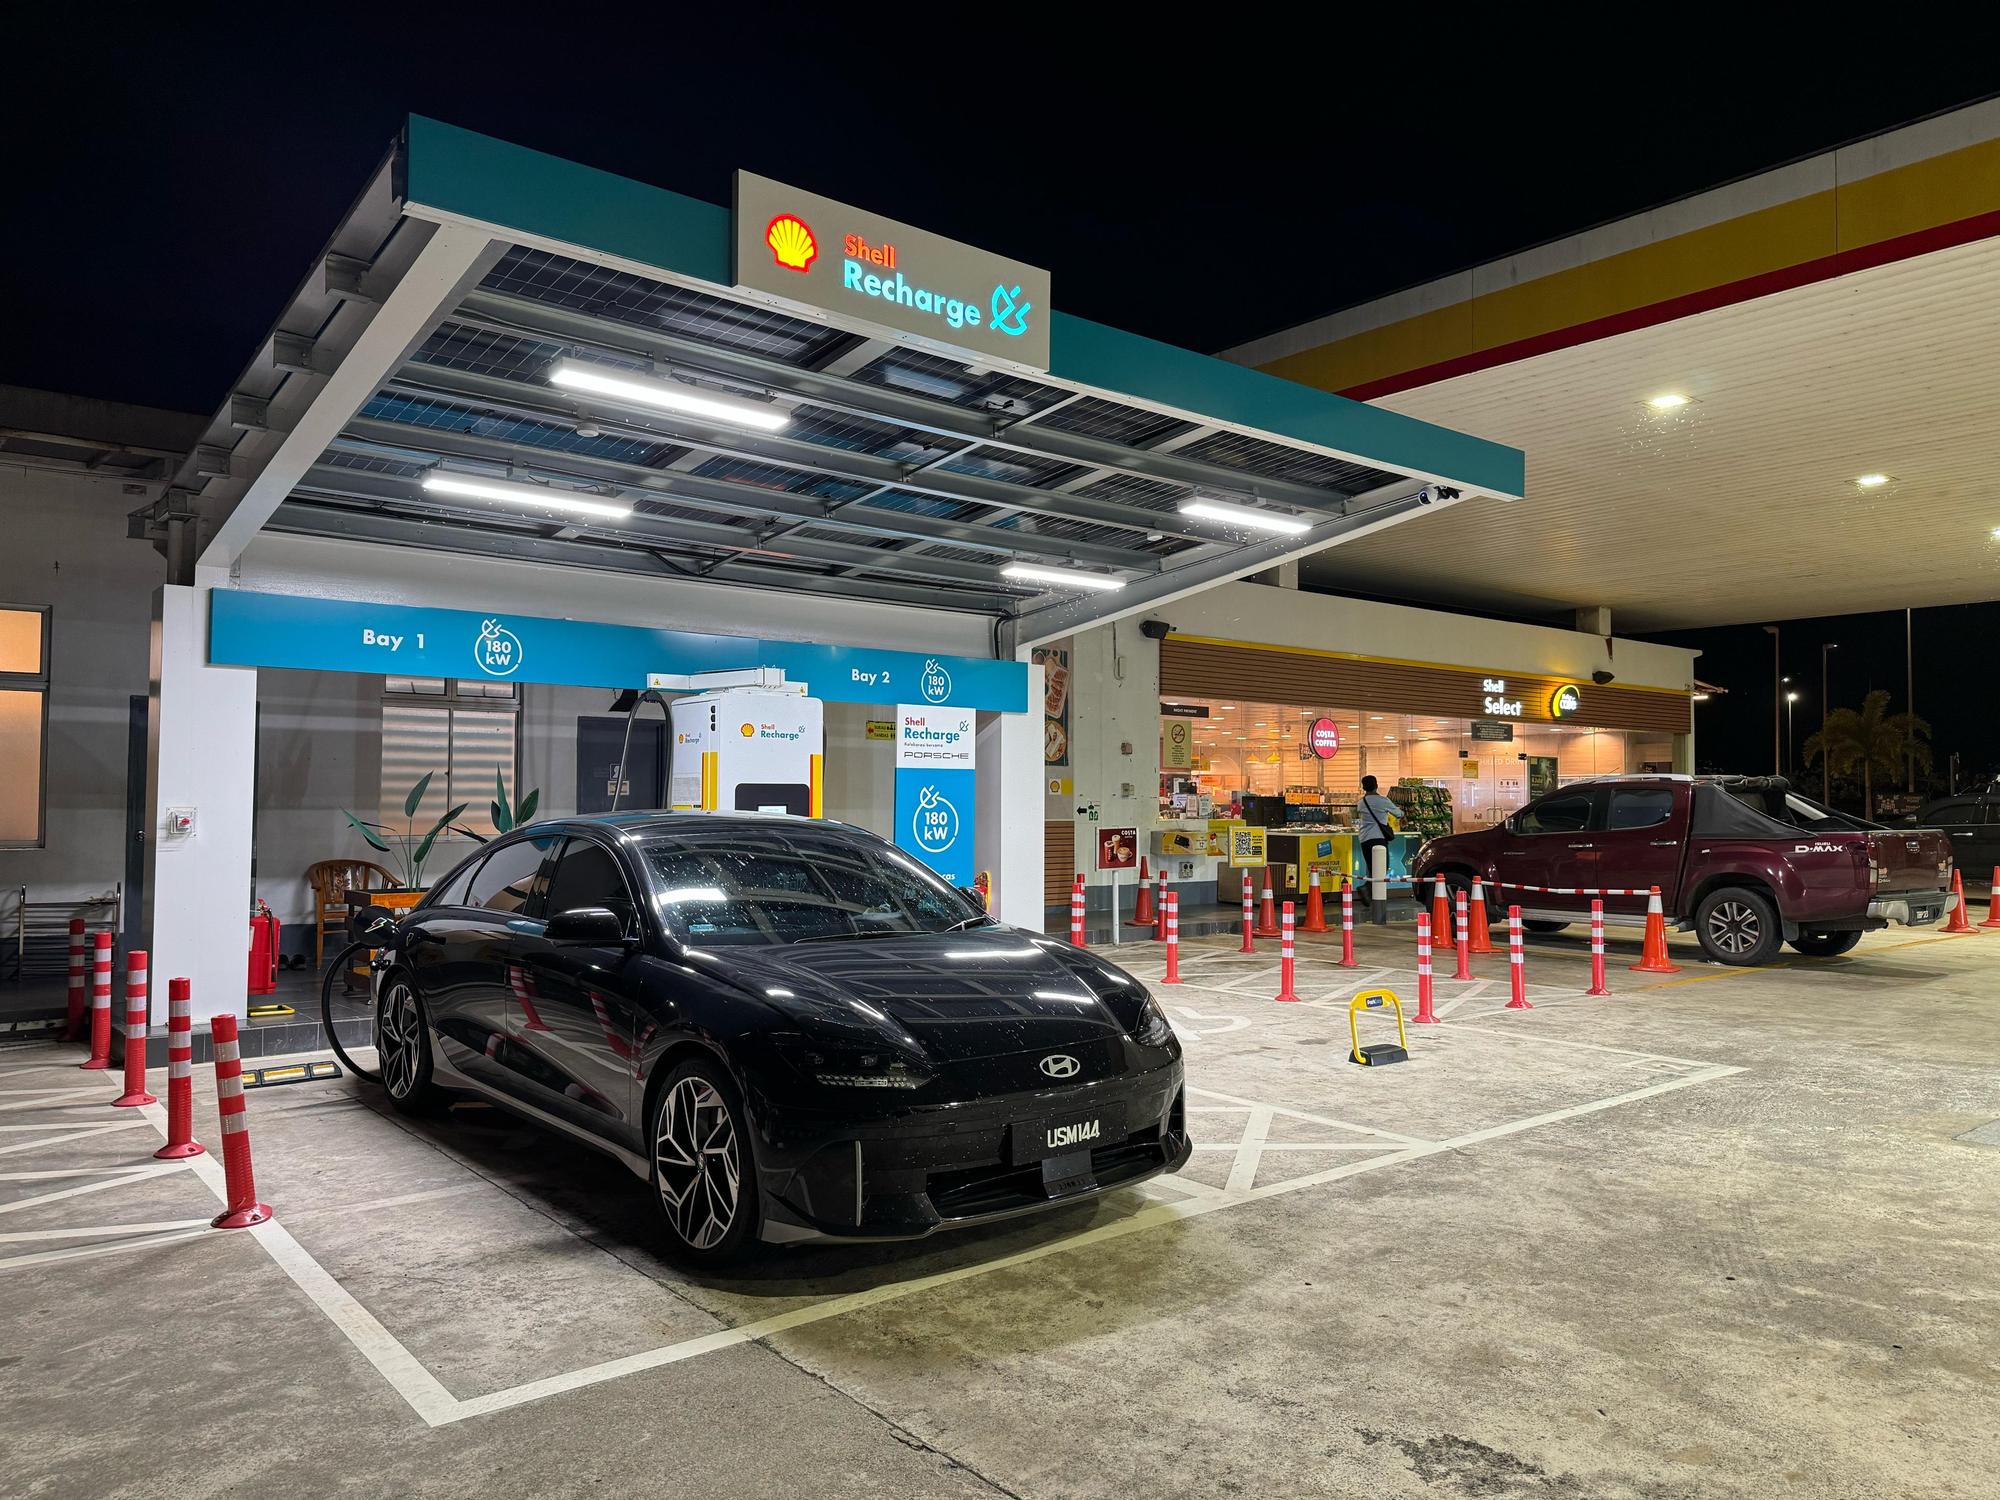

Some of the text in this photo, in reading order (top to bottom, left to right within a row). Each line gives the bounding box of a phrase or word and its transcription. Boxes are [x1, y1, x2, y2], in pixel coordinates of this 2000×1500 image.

[844, 233, 896, 269] Shell
[844, 259, 981, 329] Recharge
[362, 628, 425, 652] Bay 1
[486, 640, 512, 654] 180
[485, 653, 512, 666] kW
[851, 669, 890, 685] Bay 2
[927, 675, 945, 686] 180
[927, 686, 945, 696] kW
[1483, 679, 1504, 693] Shell
[1484, 697, 1522, 716] Select
[904, 717, 925, 726] Shell
[761, 730, 800, 741] Recharge
[904, 726, 960, 743] Recharge
[1316, 730, 1335, 738] COSTA
[1315, 739, 1337, 747] COFFEE
[925, 812, 948, 825] 180
[924, 828, 948, 841] kW
[1047, 1119, 1100, 1148] USM144
